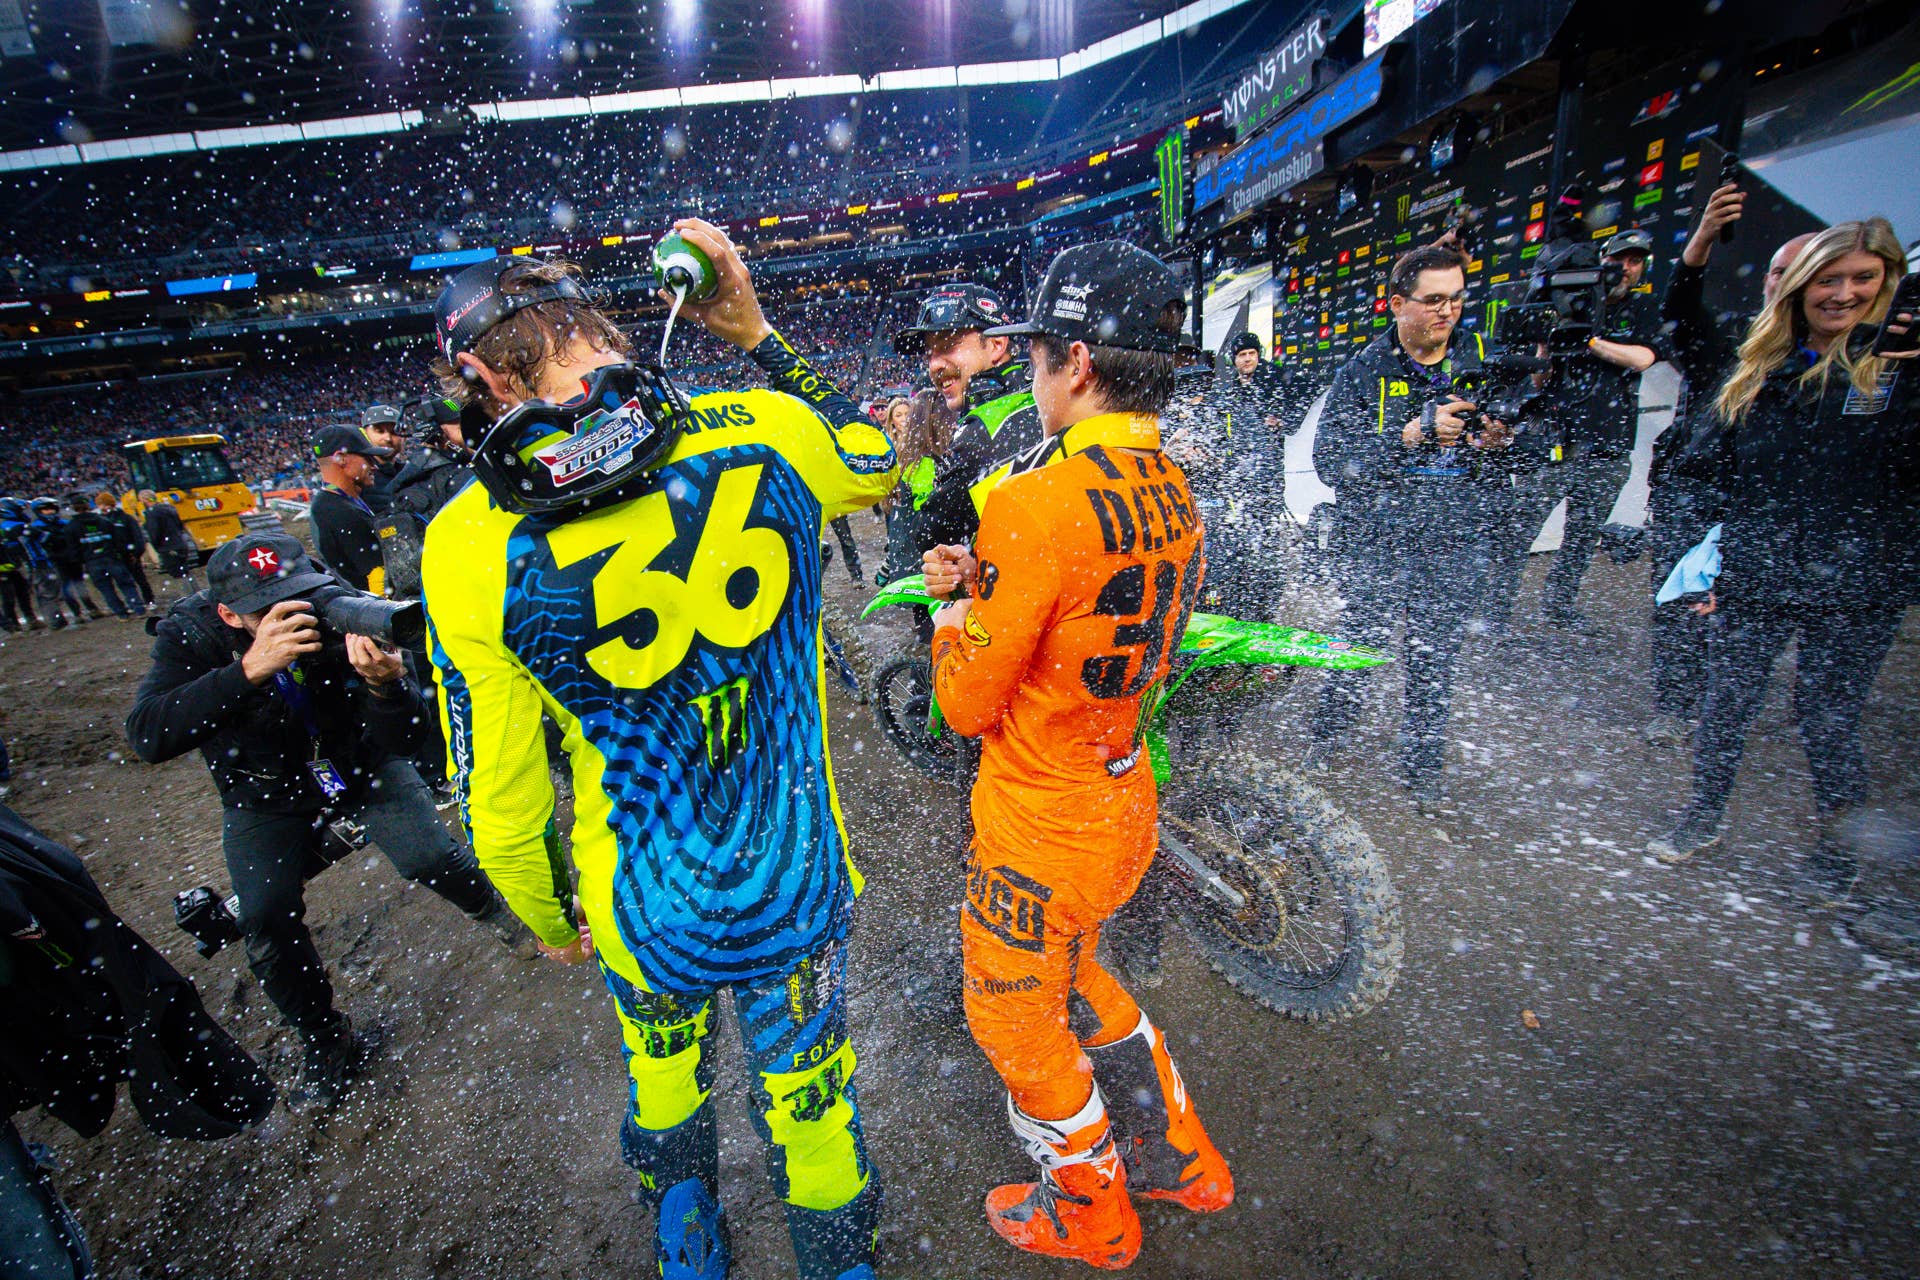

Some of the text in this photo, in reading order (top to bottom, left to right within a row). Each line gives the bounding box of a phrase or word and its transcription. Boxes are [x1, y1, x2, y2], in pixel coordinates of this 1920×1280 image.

[1223, 18, 1325, 121] MONSTER
[1237, 74, 1306, 134] ENERGY
[1193, 57, 1383, 211] SUPERCROSS
[1233, 151, 1312, 210] Championship
[1389, 381, 1409, 397] 20
[555, 417, 623, 459] SUPERCROSS
[562, 430, 634, 477] SCOTT
[195, 498, 217, 511] CAT
[545, 464, 790, 690] 36
[793, 1032, 835, 1068] FOX
